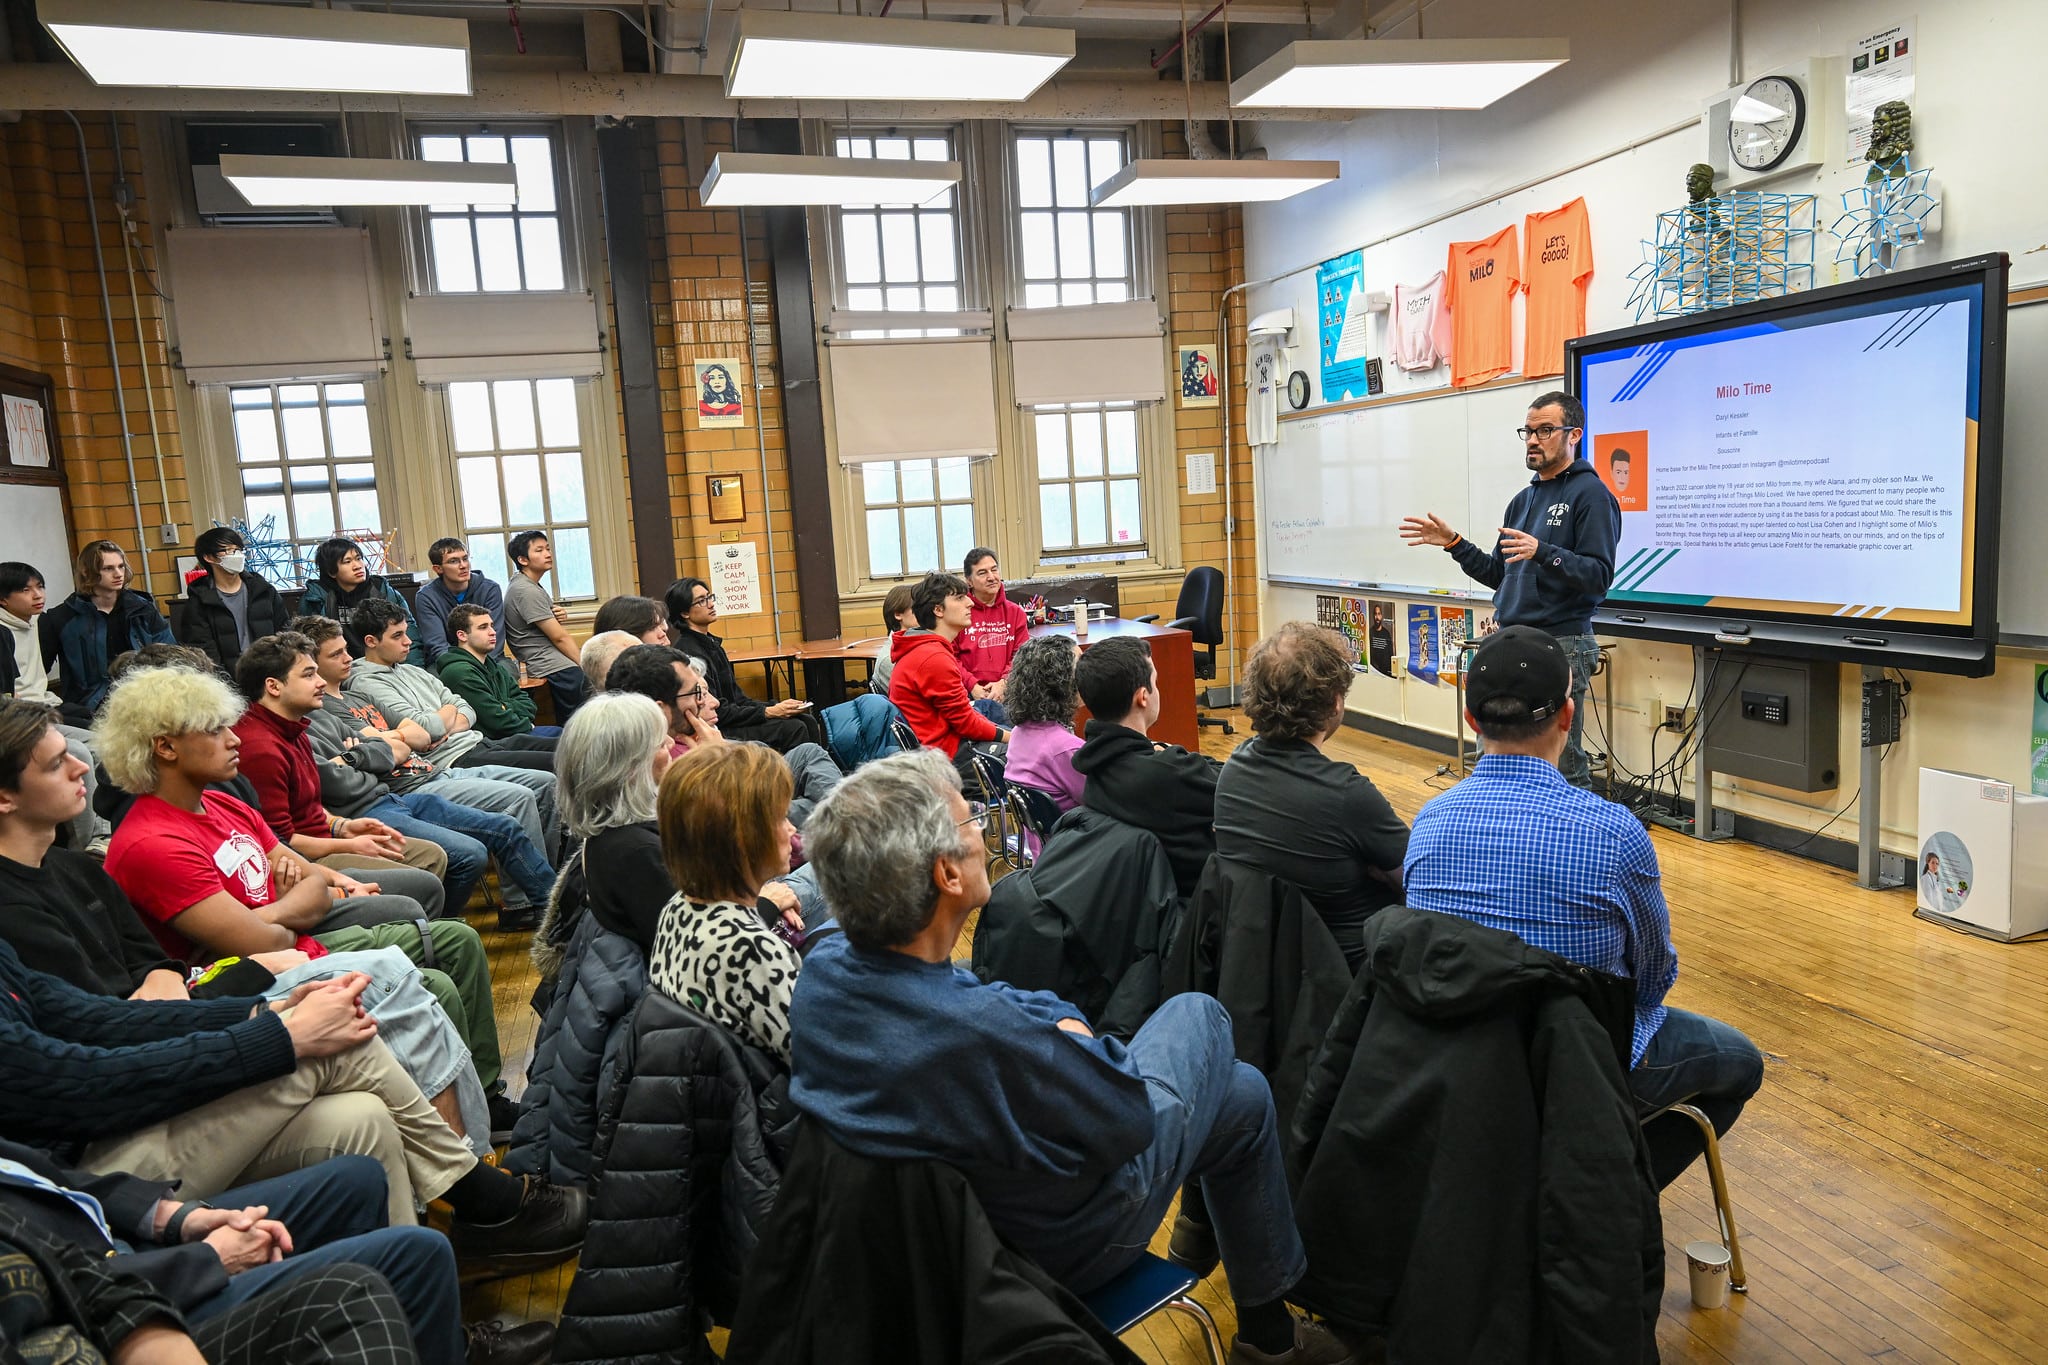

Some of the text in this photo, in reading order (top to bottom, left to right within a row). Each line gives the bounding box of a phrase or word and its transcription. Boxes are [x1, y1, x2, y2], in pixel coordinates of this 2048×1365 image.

[1872, 27, 1901, 41] Emergency
[1545, 235, 1566, 249] LET'S
[1541, 245, 1570, 264] GOOOO!
[1469, 261, 1494, 282] MILO
[1716, 382, 1772, 399] Milo Time
[5, 400, 48, 464] MATH
[1750, 460, 1776, 469] Instagram
[1872, 476, 1889, 484] older
[1811, 489, 1834, 498] opened
[1885, 488, 1905, 496] many
[1905, 486, 1929, 496] people
[1621, 495, 1636, 504] Time
[1838, 499, 1860, 508] figured
[1835, 510, 1860, 519] podcast
[1861, 521, 1888, 529] highlight
[1917, 520, 1938, 528] Milo's
[1858, 542, 1882, 551] graphic
[724, 562, 743, 570] KEEP
[723, 571, 745, 579] CALM
[723, 585, 748, 593] SHOW
[726, 594, 748, 602] YOUR
